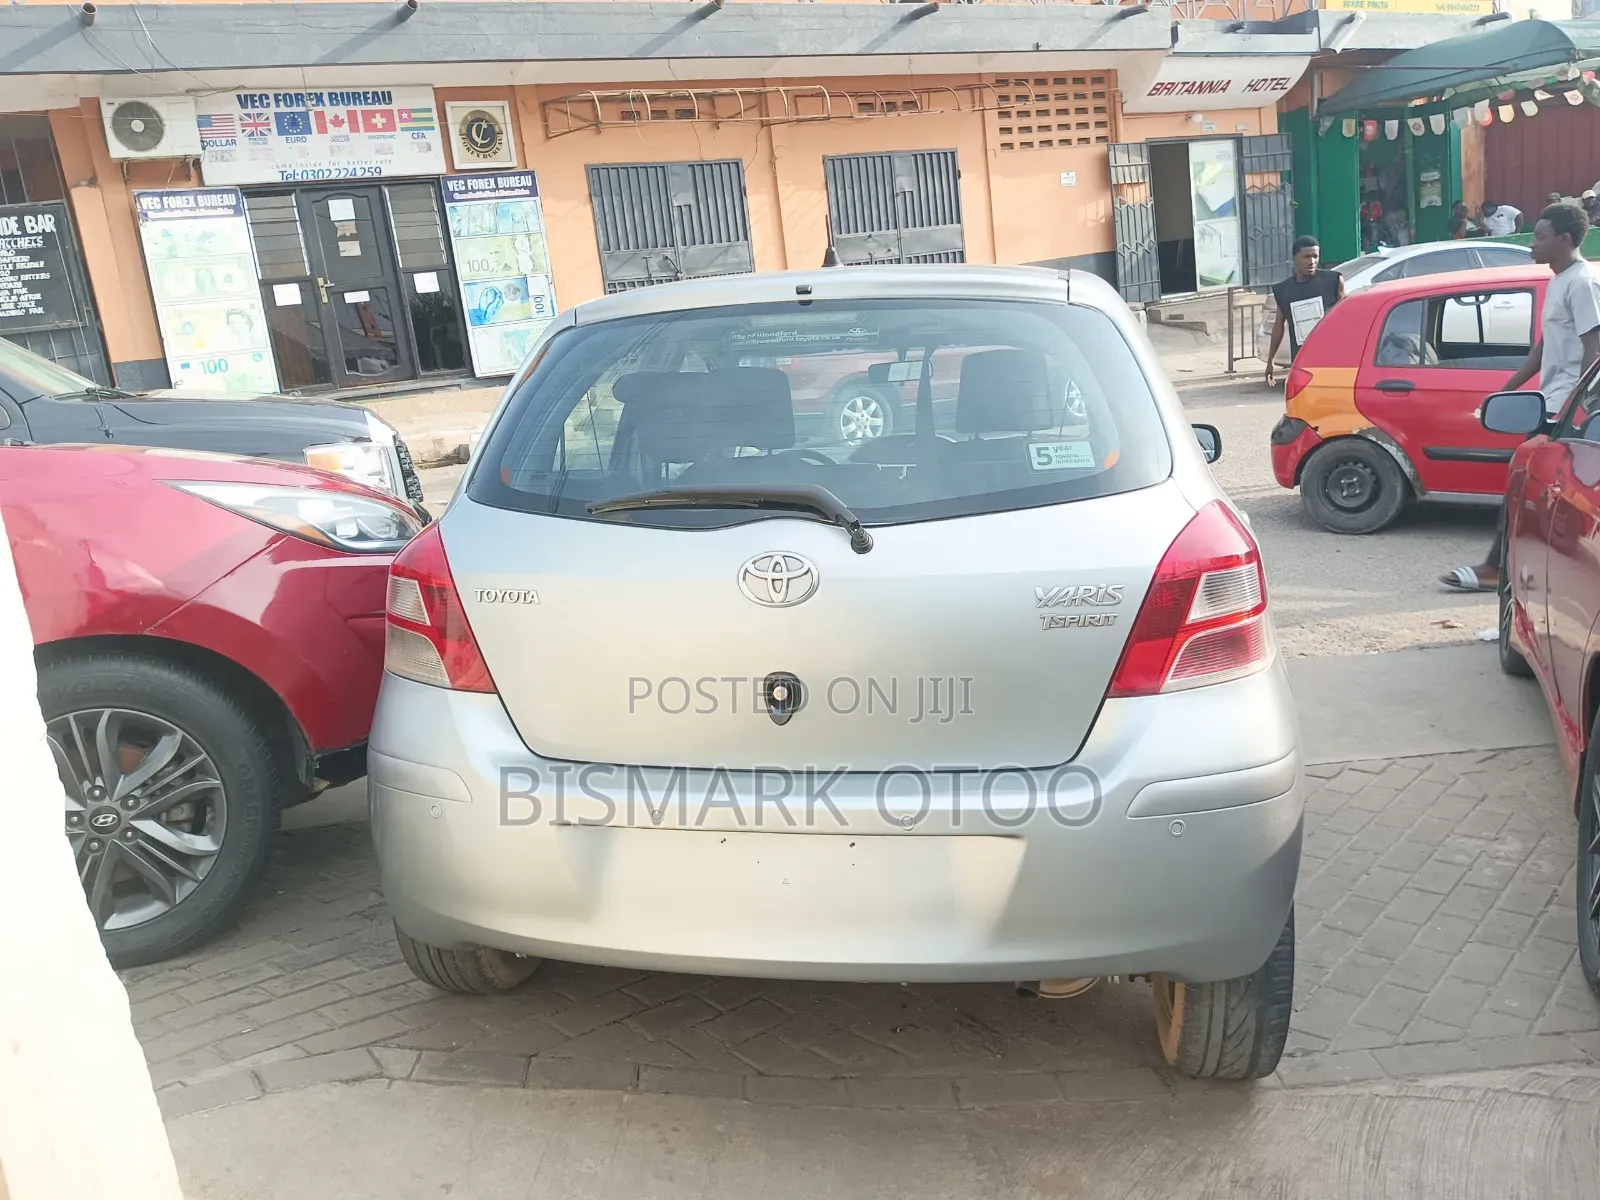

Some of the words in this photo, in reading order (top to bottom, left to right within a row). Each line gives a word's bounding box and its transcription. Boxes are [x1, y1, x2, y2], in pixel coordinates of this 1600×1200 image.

[1147, 79, 1232, 96] BRITANNIA
[1242, 77, 1291, 92] HOTEL
[236, 93, 271, 109] VEC
[273, 91, 326, 108] FOREX
[328, 90, 393, 107] BUREAU
[201, 139, 237, 148] DOLLAR
[285, 136, 308, 144] EURO
[411, 132, 427, 140] CFA
[461, 135, 480, 159] FOREX
[482, 136, 503, 159] BUREAU
[446, 179, 466, 192] VEC
[467, 177, 496, 191] FOREX
[497, 175, 532, 189] BUREAU
[140, 196, 162, 210] VEC
[163, 195, 196, 209] FOREX
[197, 193, 237, 207] BUREAU
[23, 213, 57, 234] BAR
[467, 258, 490, 273] 100
[534, 296, 545, 315] 100
[198, 358, 229, 375] 100
[1035, 446, 1053, 466] 5
[1053, 445, 1073, 454] year
[475, 588, 541, 605] TOYOTA
